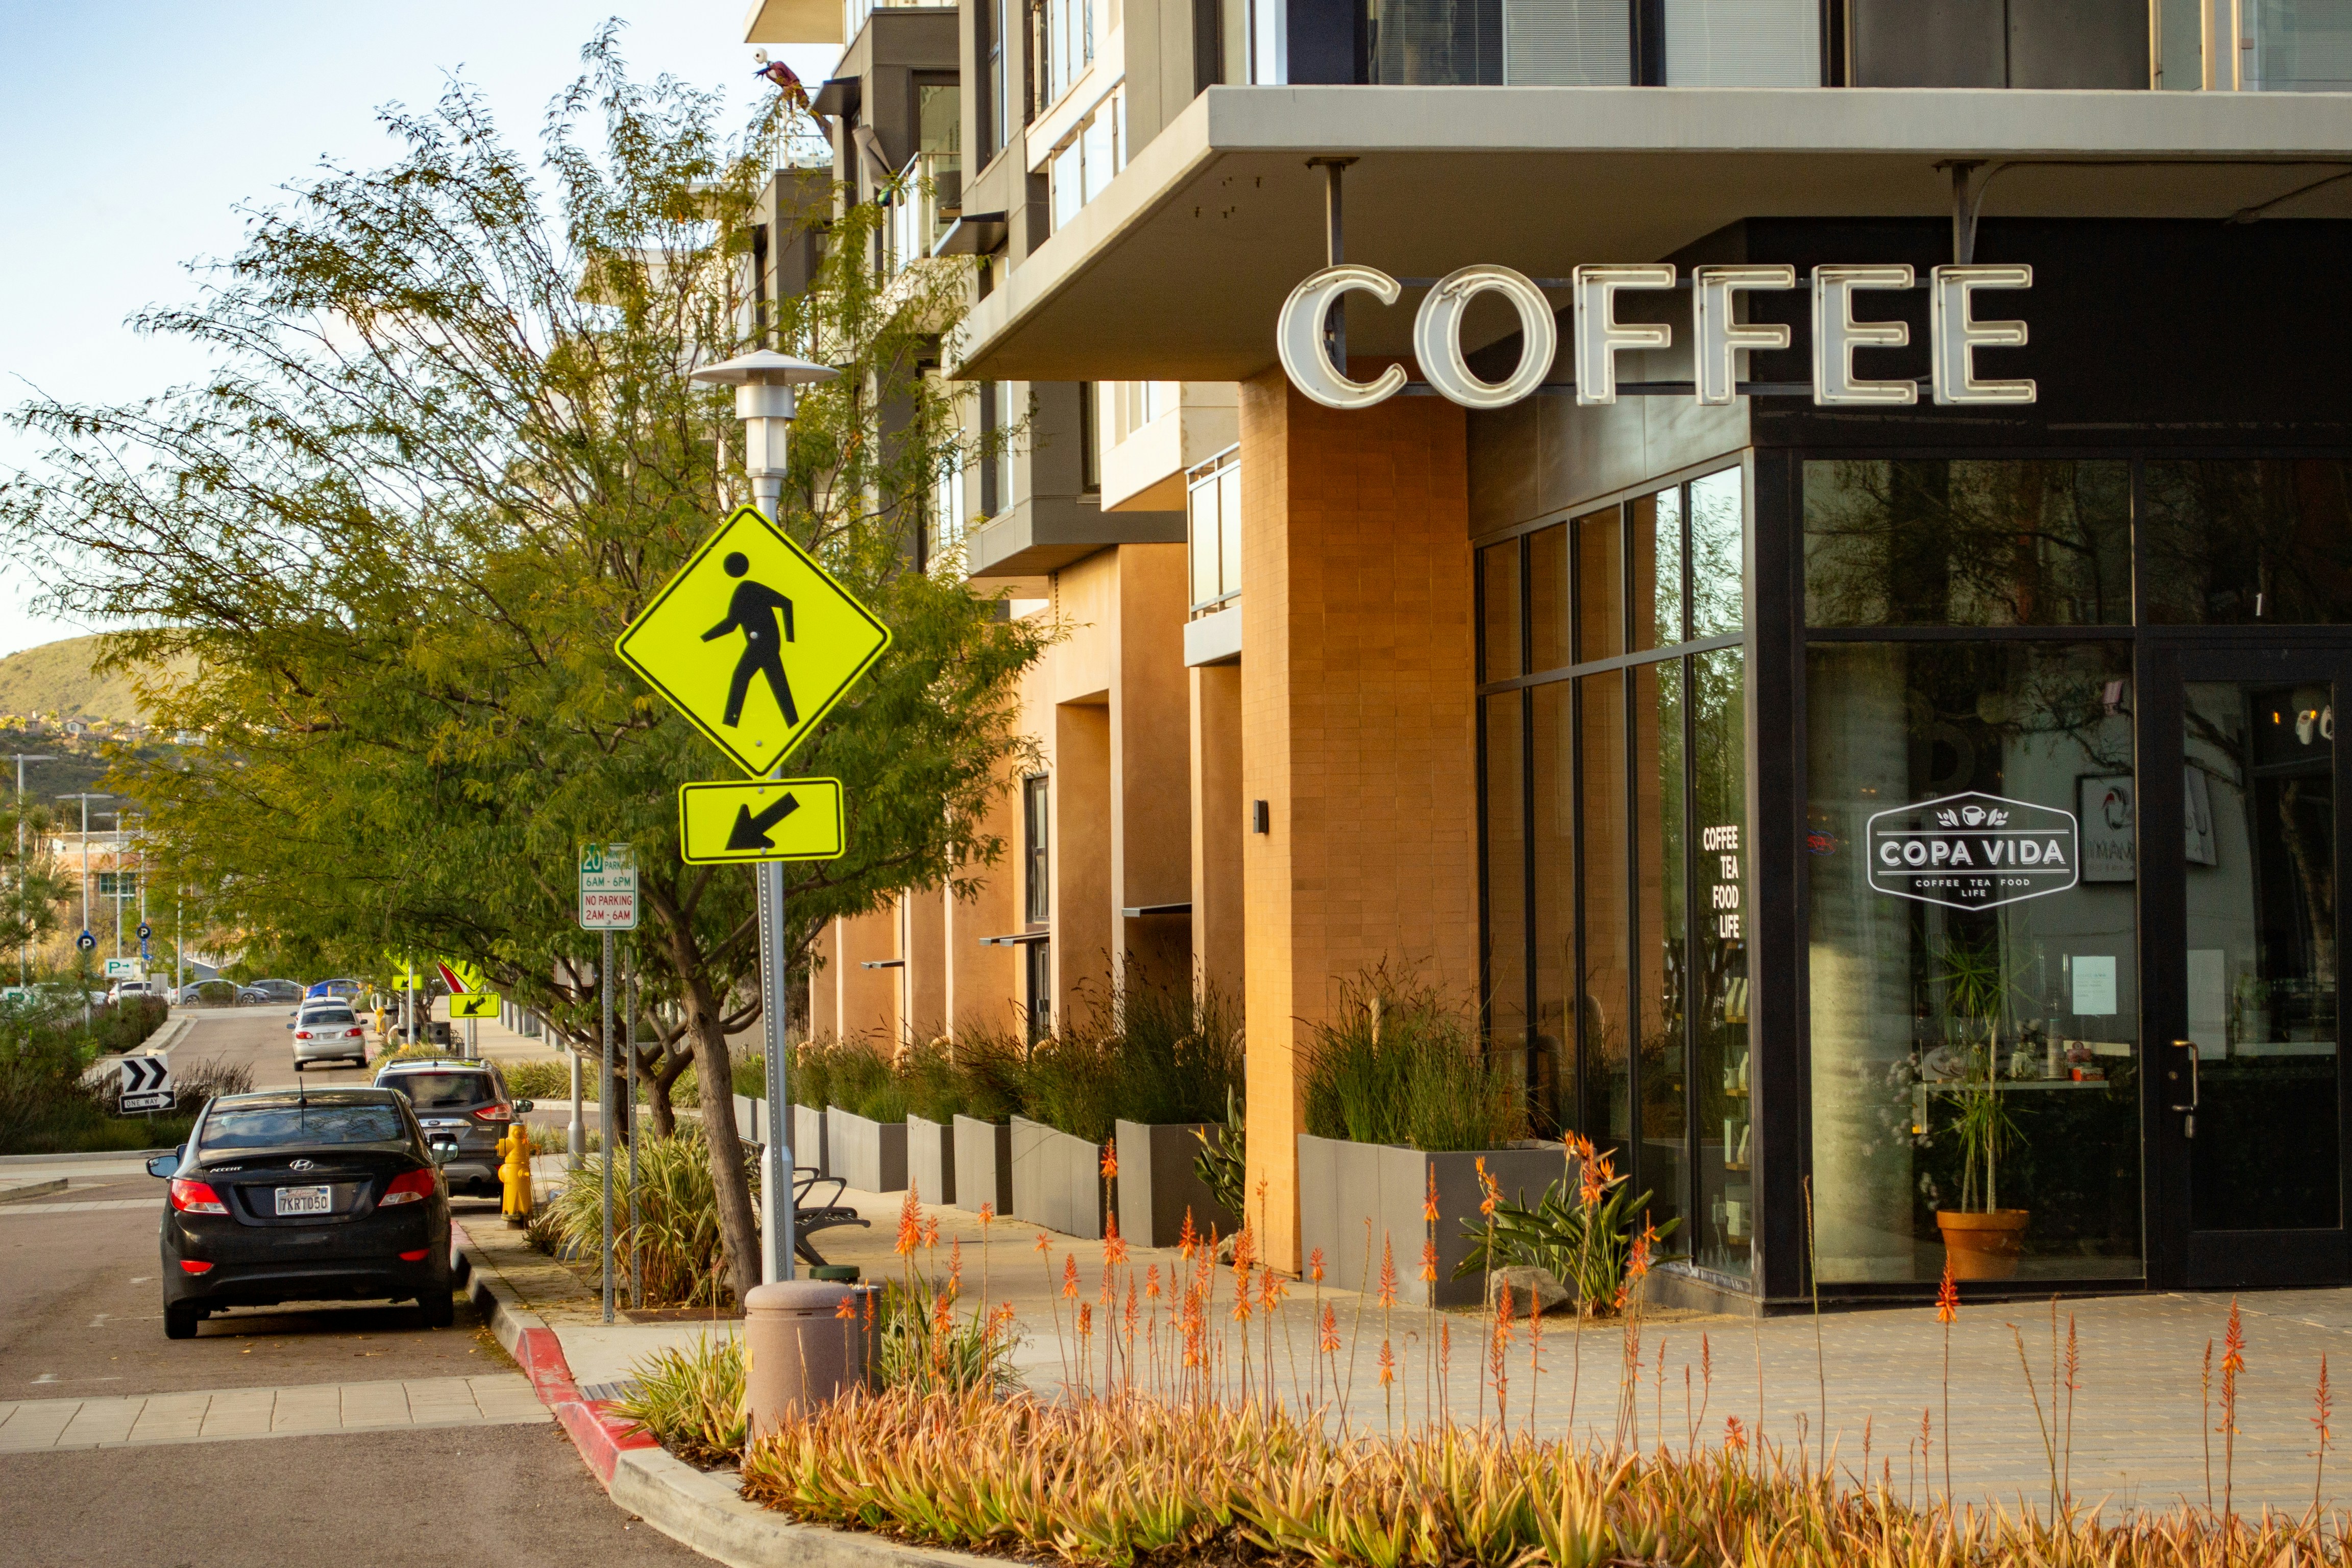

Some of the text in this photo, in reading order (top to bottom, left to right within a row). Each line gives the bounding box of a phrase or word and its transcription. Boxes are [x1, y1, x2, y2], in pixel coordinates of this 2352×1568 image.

[1276, 263, 2036, 408] COFFEE
[1703, 825, 1738, 851] COFFEE
[583, 850, 601, 870] 20
[1880, 840, 2067, 866] COPA VIDA
[1720, 855, 1738, 879] TEA
[586, 877, 604, 886] 6AM
[613, 877, 630, 886] 6PM
[1916, 879, 1959, 888] COFFEE
[585, 896, 632, 905] NO PARKING
[1713, 885, 1739, 909] FOOD
[586, 910, 604, 920] 2AM
[612, 910, 630, 920] 6AM
[1720, 914, 1739, 938] LIFE
[280, 1196, 327, 1211] 7KRT050
